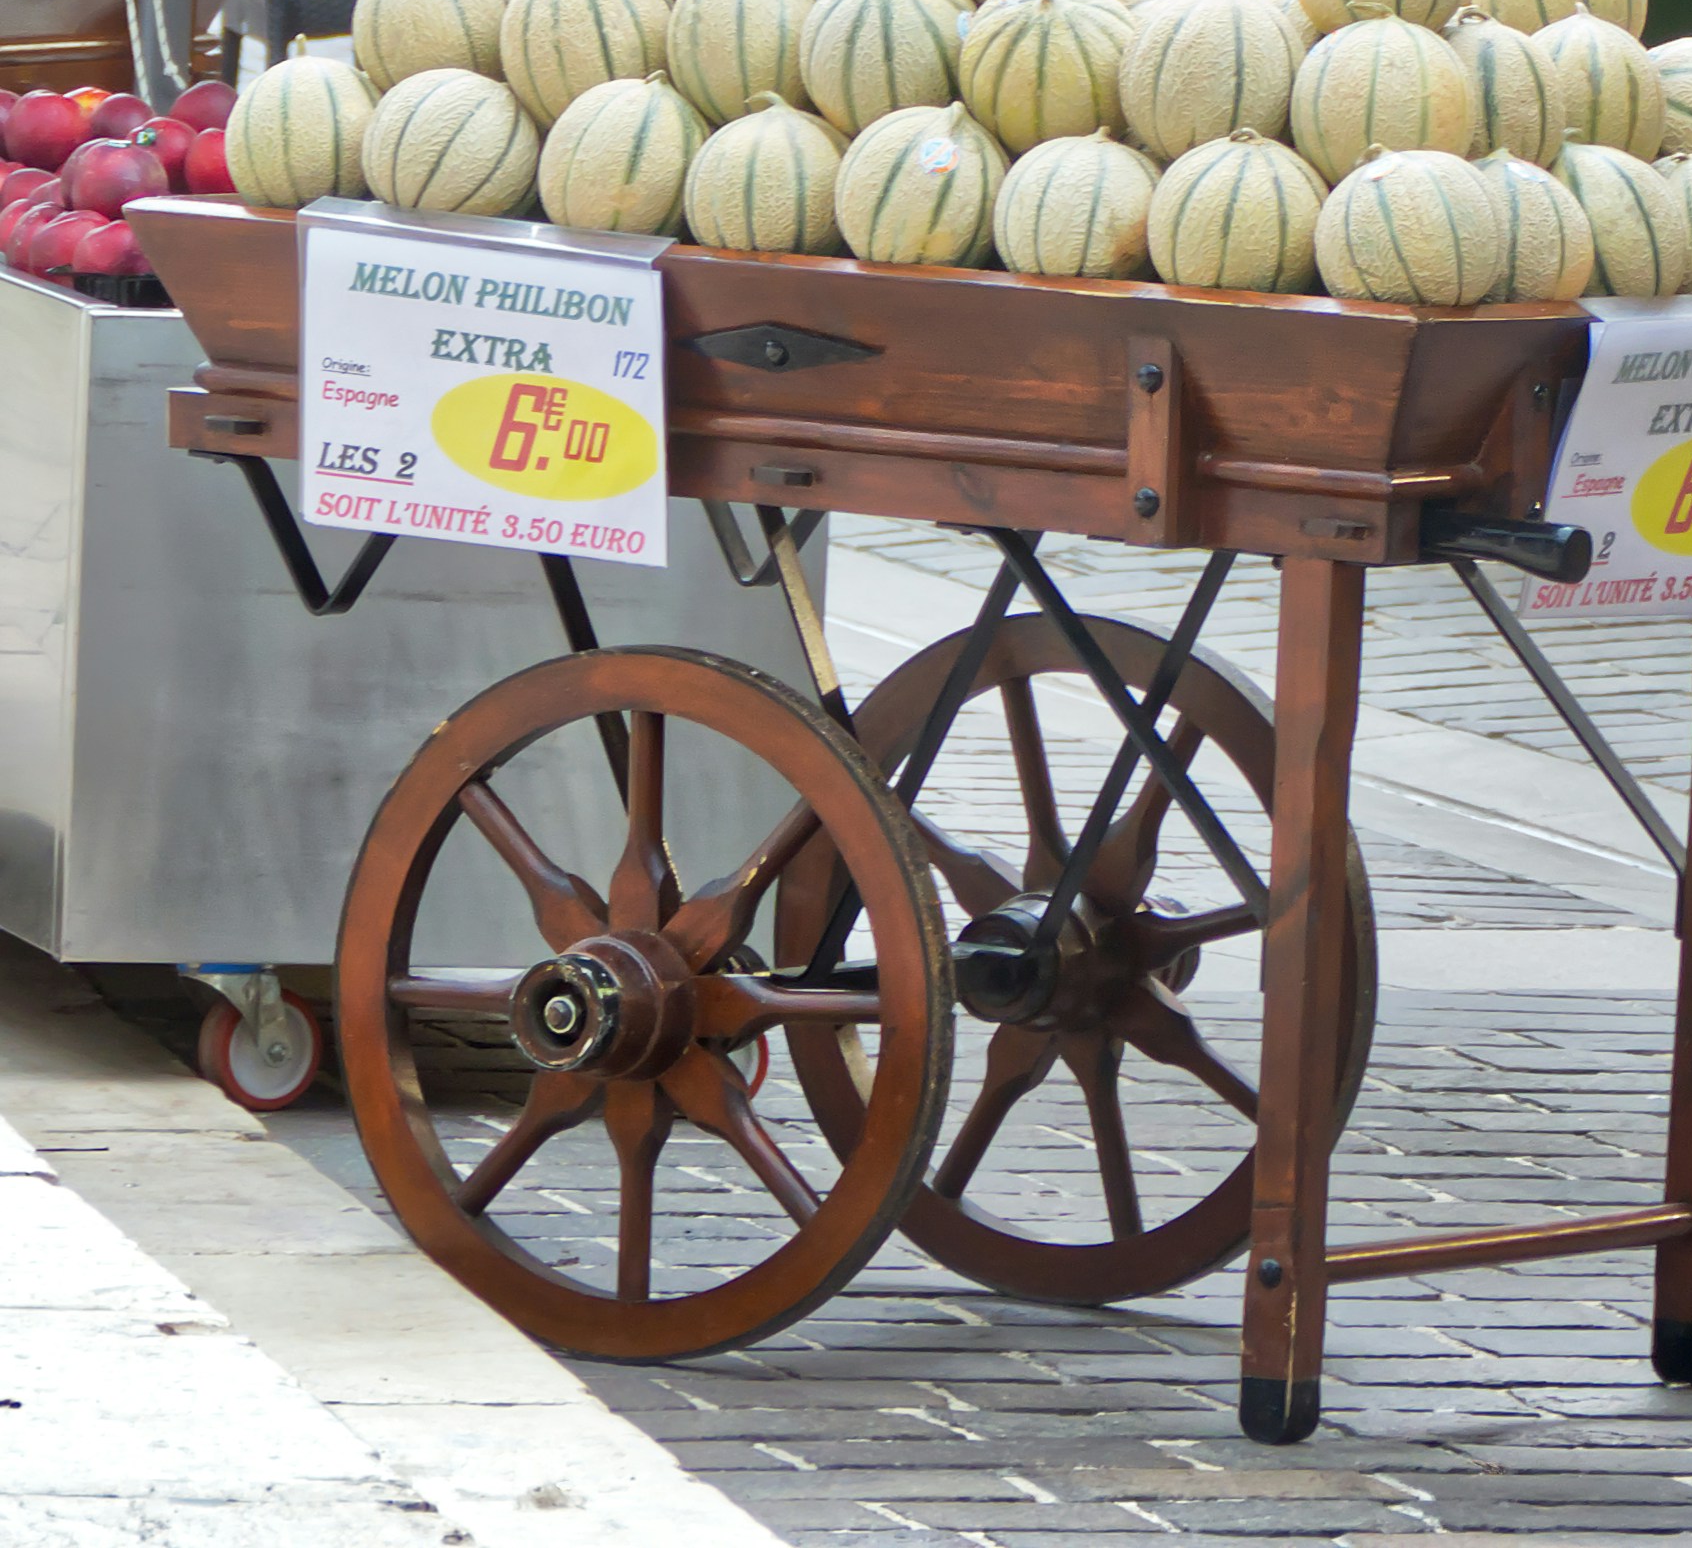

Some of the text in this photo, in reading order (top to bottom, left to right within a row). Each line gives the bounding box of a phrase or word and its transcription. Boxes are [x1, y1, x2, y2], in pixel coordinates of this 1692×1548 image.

[349, 262, 634, 326] MELON PHILIBON
[322, 357, 371, 375] Origine:
[431, 329, 552, 373] EXTRA
[612, 351, 650, 380] 172
[322, 380, 399, 410] Espagne
[317, 442, 417, 480] LES 2
[315, 492, 645, 554] SOIT L'UNITÉ 3.50 EURO
[1597, 531, 1616, 560] 2
[1531, 582, 1582, 609] SOIT
[1579, 572, 1657, 606] L'UNITÉ
